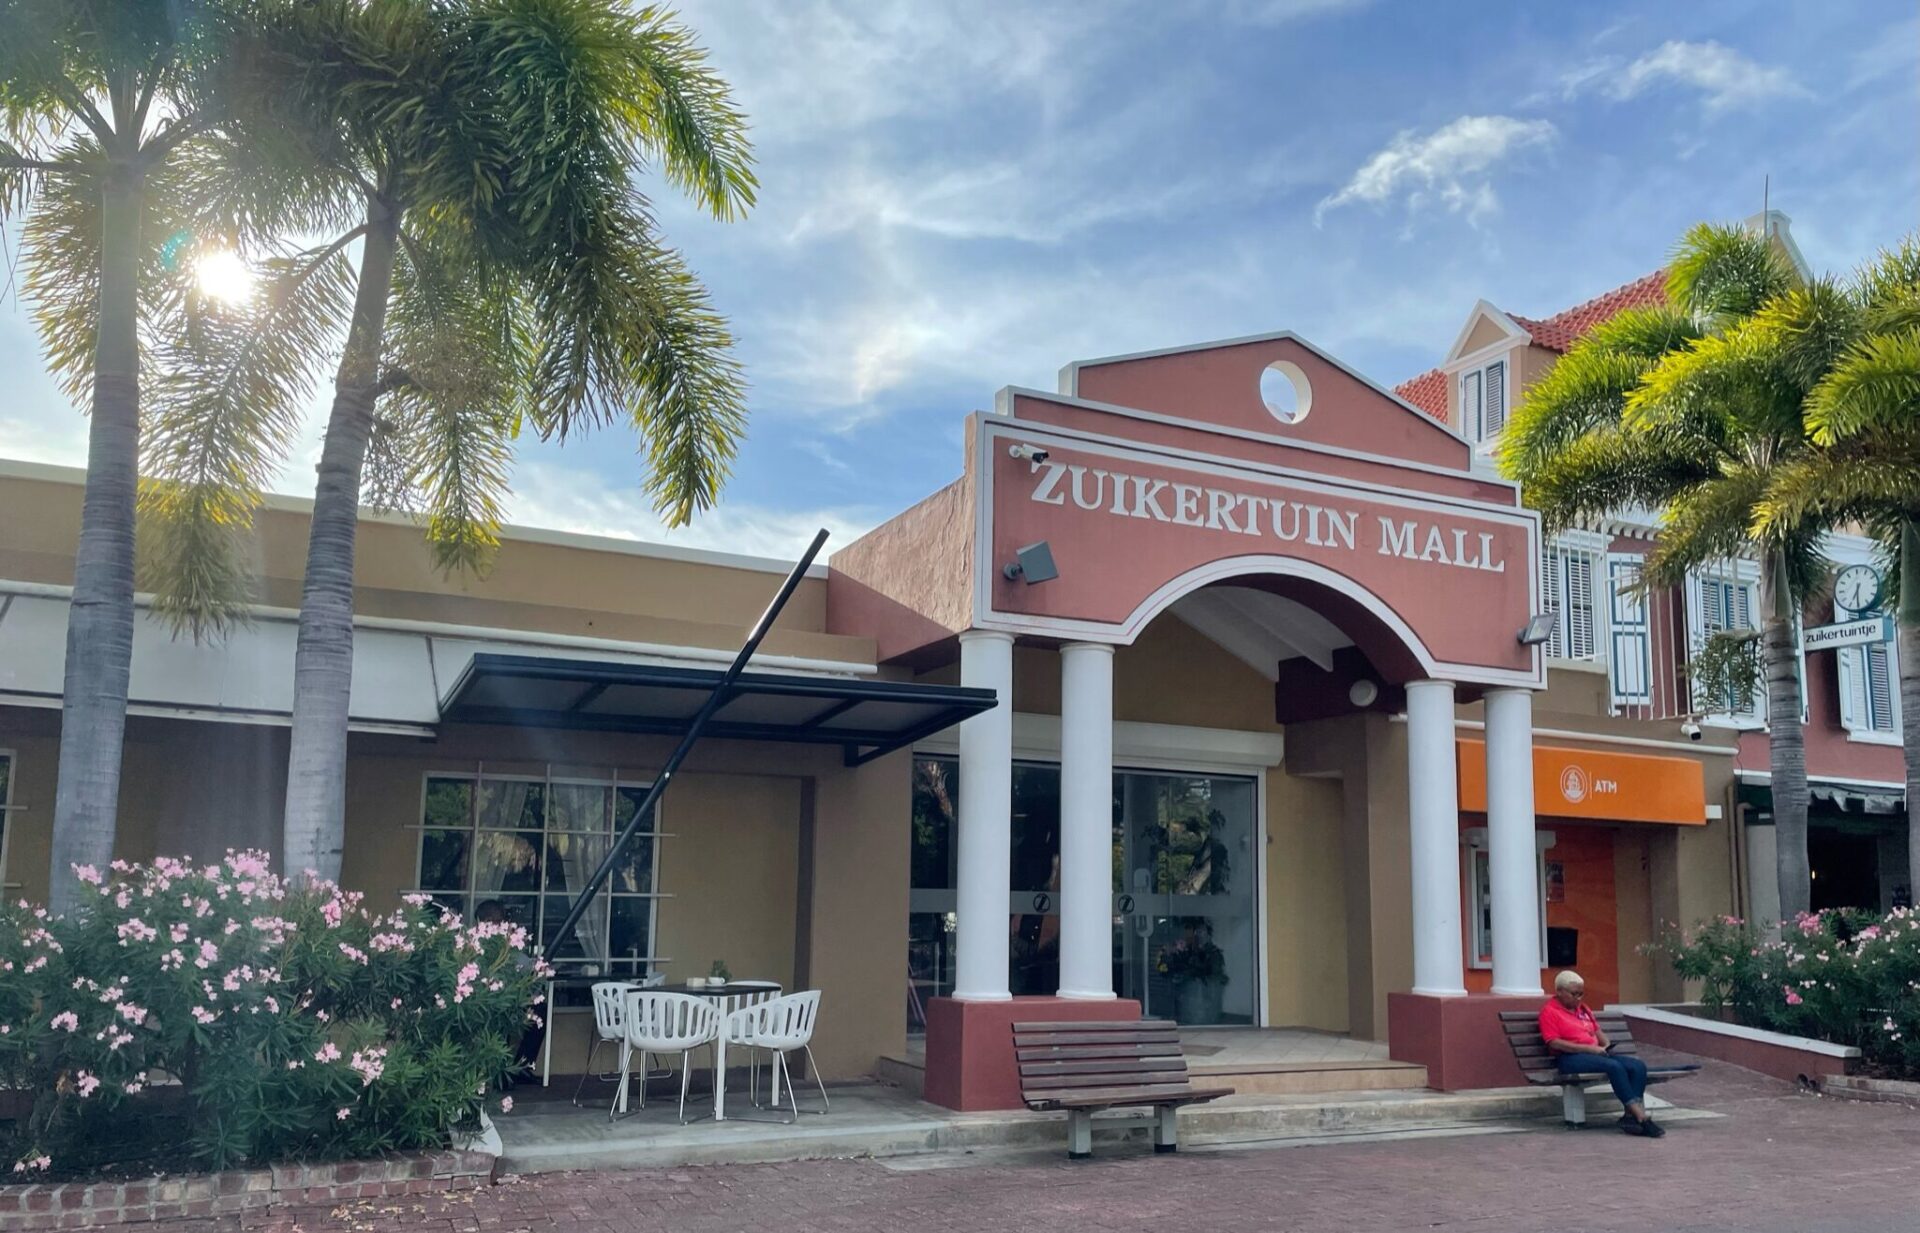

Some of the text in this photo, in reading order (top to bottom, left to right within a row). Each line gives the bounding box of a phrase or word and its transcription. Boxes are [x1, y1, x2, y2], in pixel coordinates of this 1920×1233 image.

[1030, 460, 1506, 573] ZUIKERTUIN MALL
[1805, 624, 1876, 643] zuikertuintje
[1594, 779, 1618, 795] ATM
